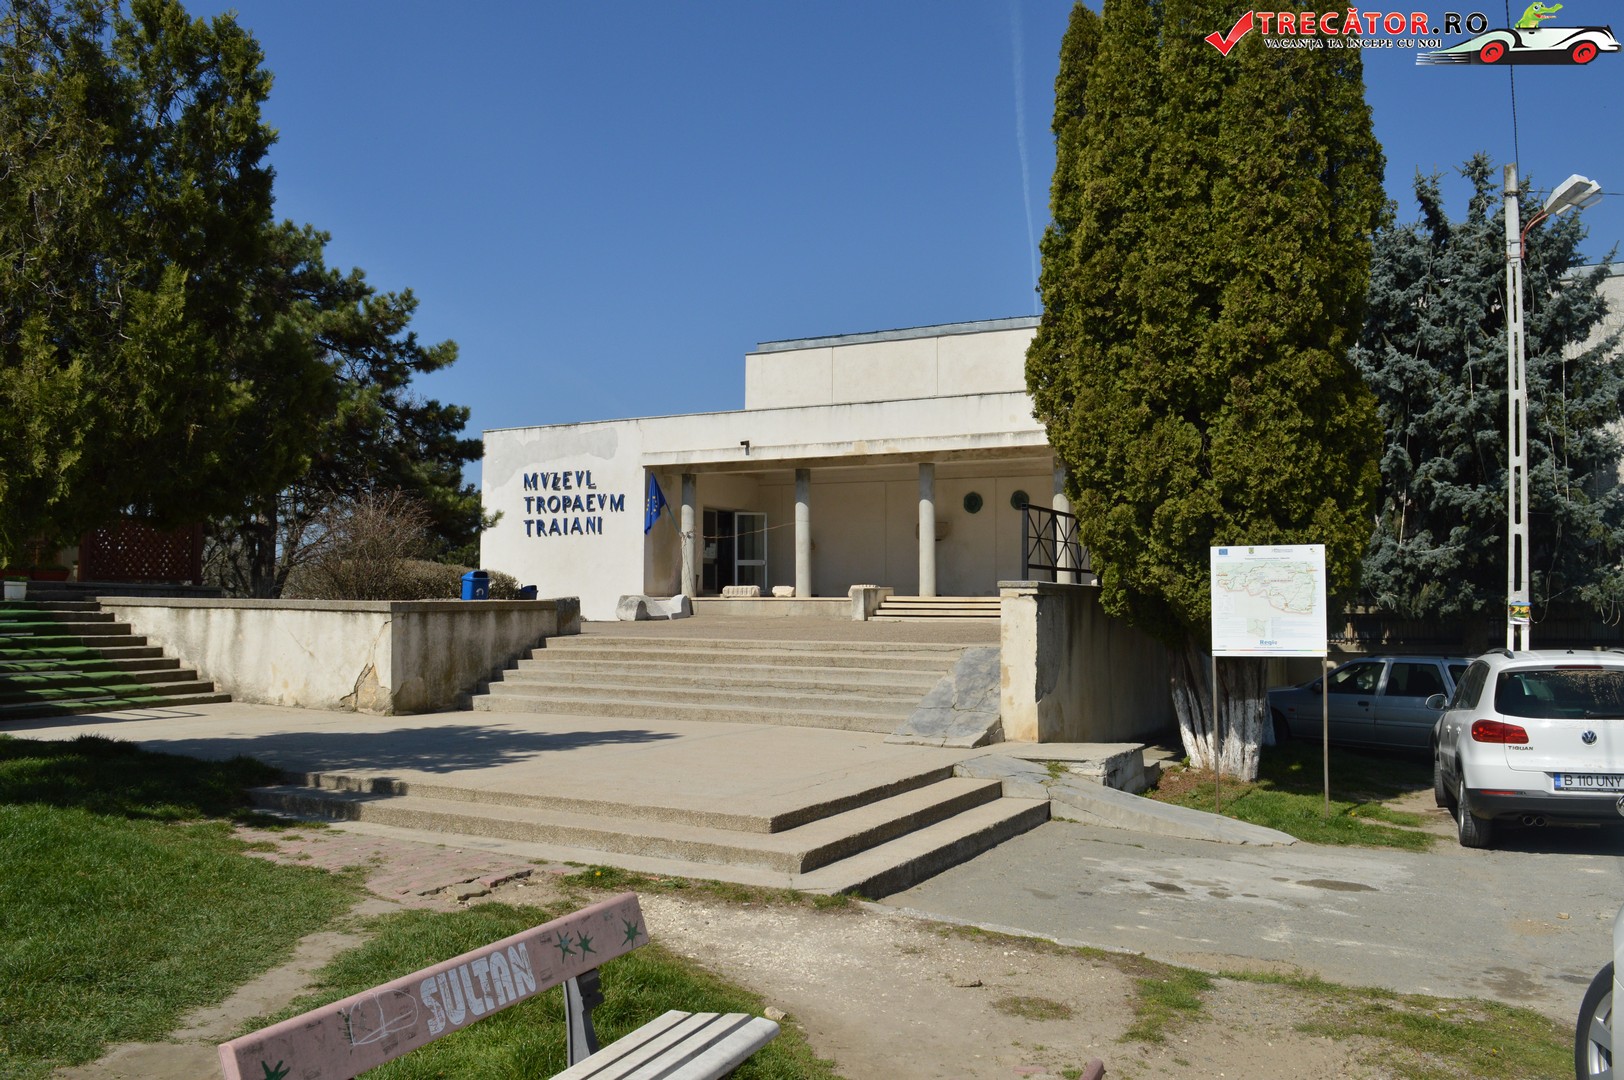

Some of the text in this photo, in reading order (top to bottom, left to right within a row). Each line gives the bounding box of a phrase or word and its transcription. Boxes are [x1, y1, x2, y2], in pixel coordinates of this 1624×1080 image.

[524, 493, 625, 515] TROPAEVM
[524, 516, 603, 537] TRAIANI
[1564, 774, 1622, 787] B 110 UNY
[420, 942, 536, 1036] SULTAN
